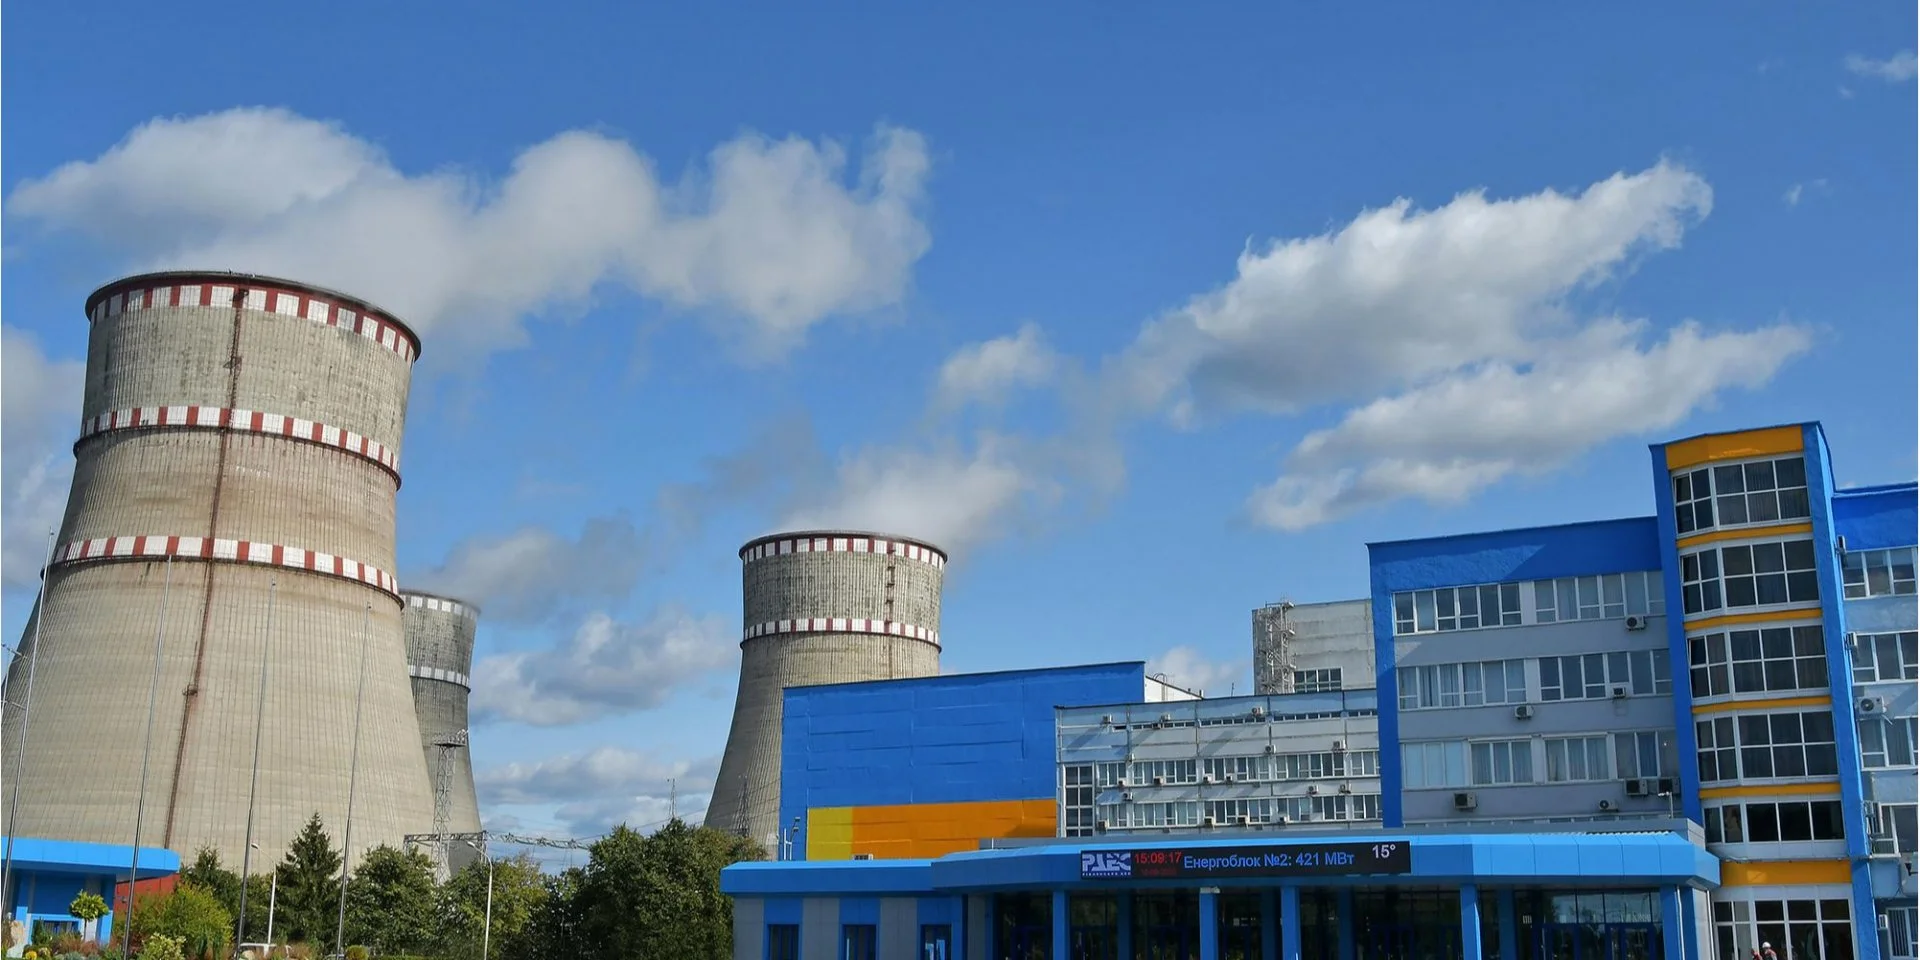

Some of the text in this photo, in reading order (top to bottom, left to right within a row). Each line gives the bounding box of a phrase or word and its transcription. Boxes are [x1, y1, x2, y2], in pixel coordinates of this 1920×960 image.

[1135, 852, 1182, 864] 15:09:17
[1184, 854, 1261, 871] Енергоблок
[1295, 852, 1319, 866] 421
[1325, 852, 1355, 865] МВт
